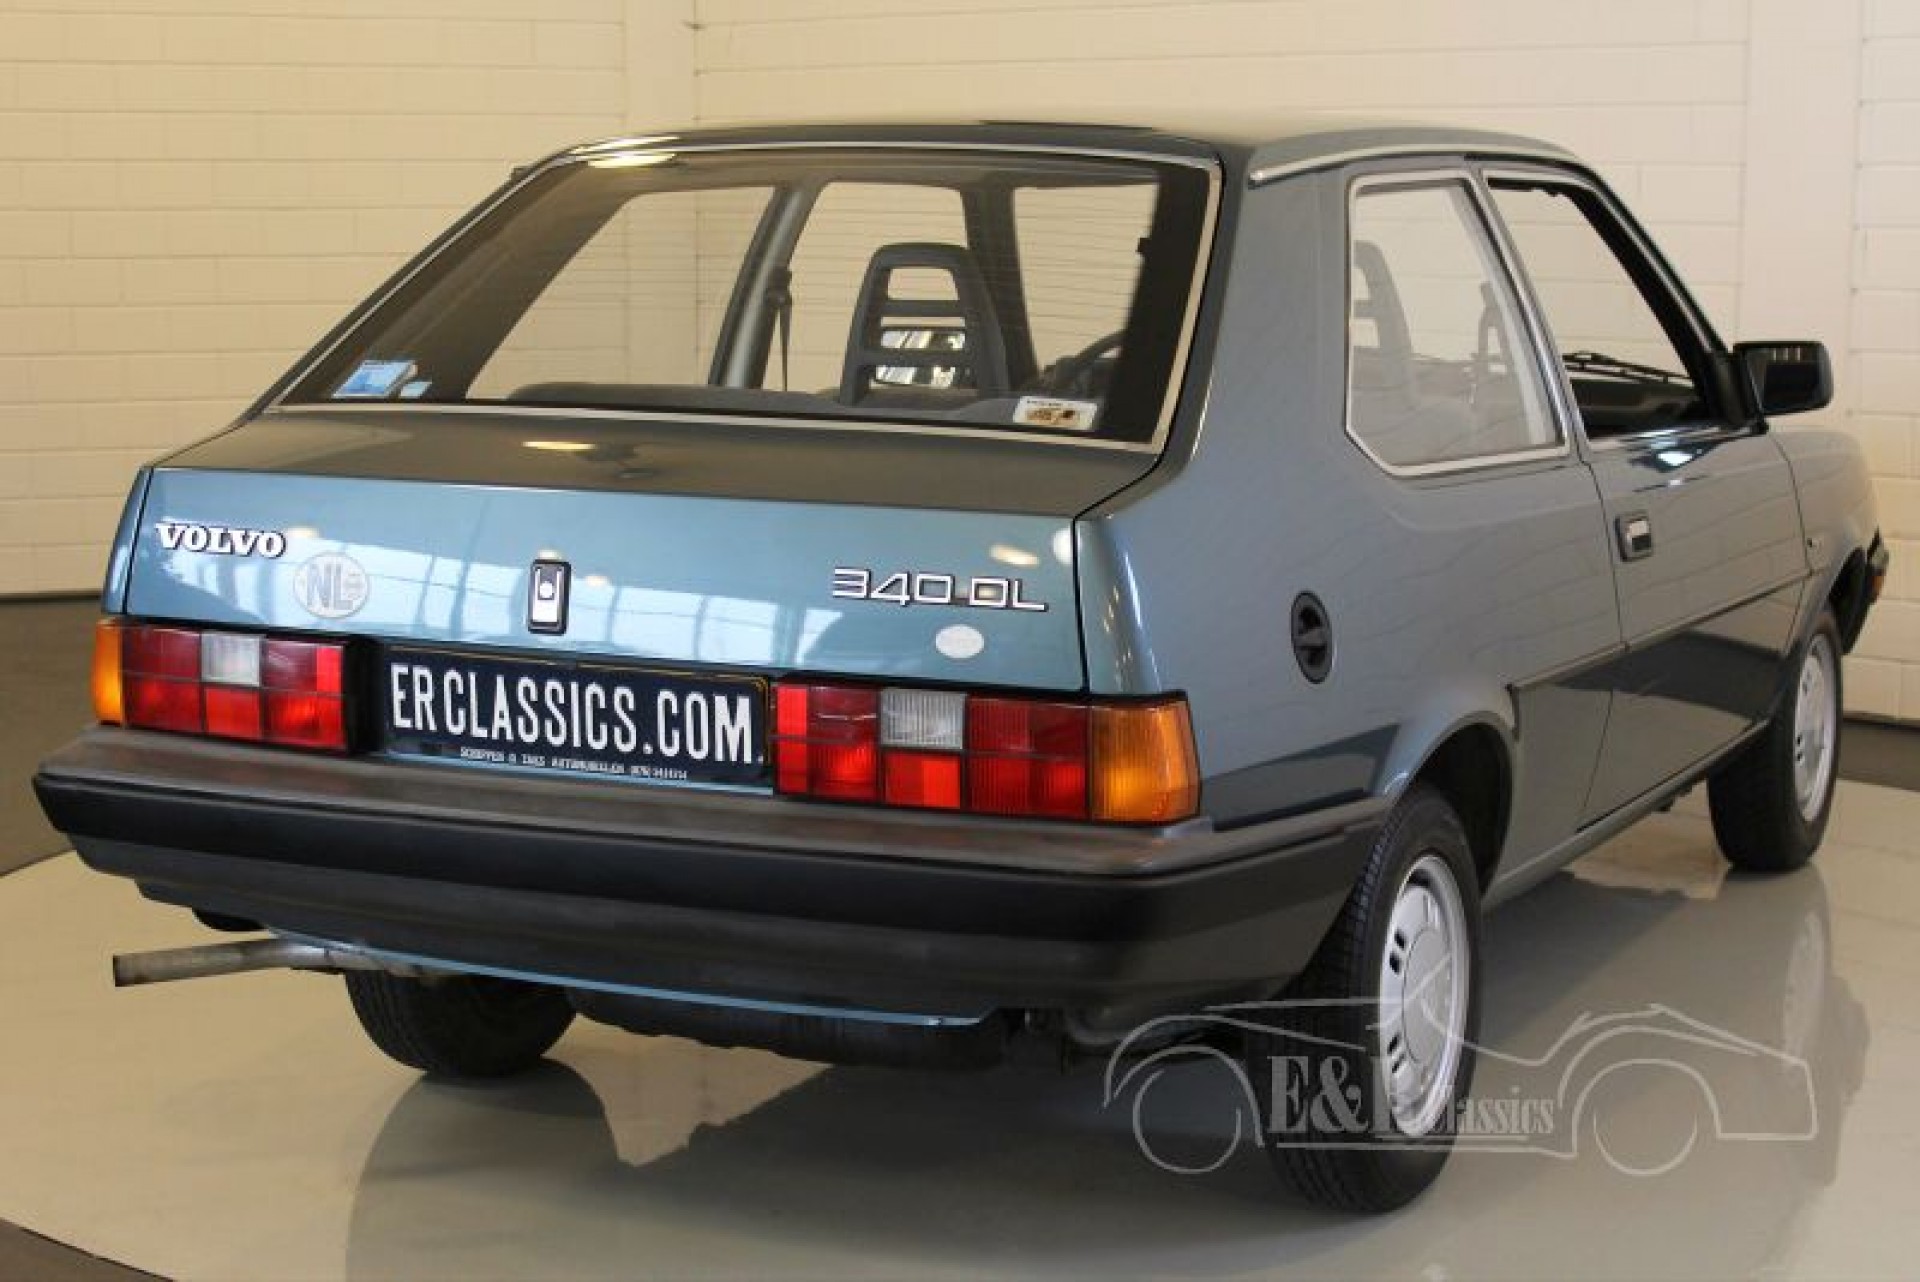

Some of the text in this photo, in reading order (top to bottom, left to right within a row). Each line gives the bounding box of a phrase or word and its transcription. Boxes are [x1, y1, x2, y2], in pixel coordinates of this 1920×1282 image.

[155, 521, 287, 558] VOLVO
[832, 567, 1049, 612] 340 DL
